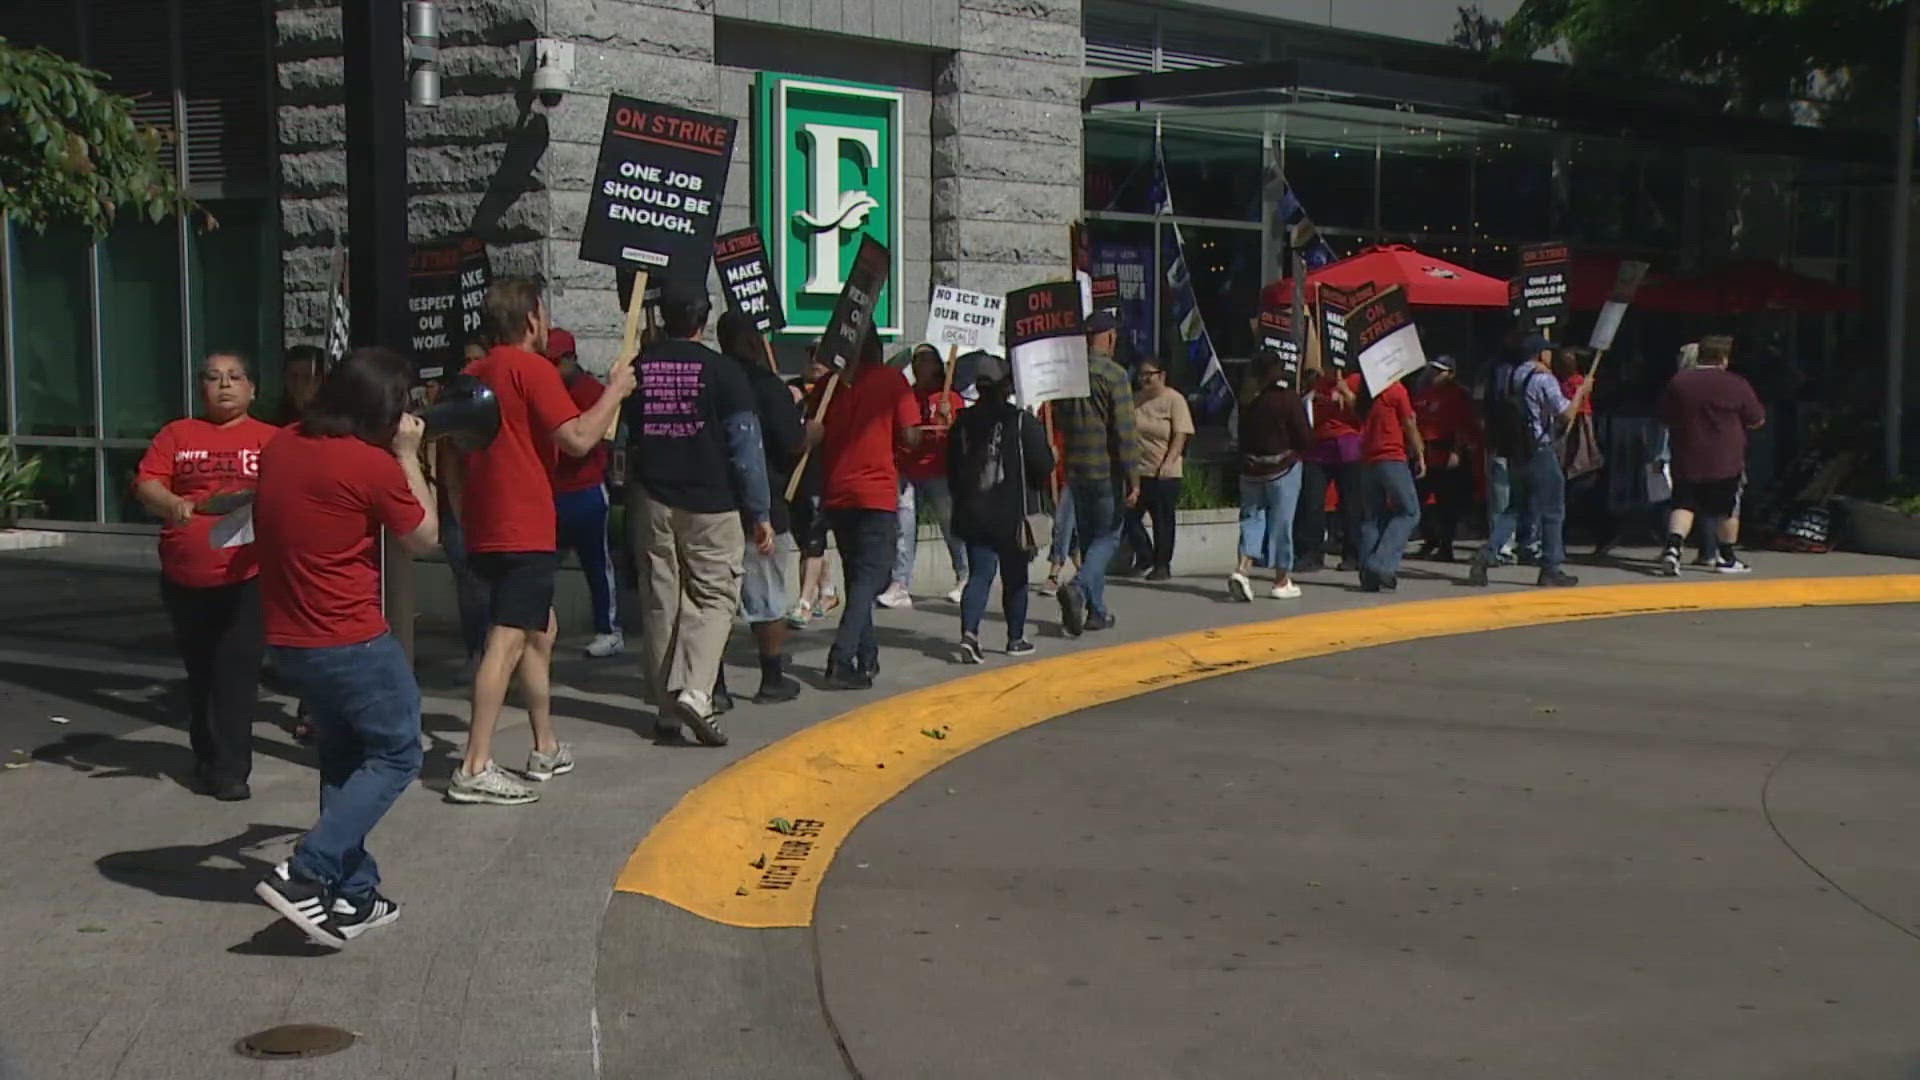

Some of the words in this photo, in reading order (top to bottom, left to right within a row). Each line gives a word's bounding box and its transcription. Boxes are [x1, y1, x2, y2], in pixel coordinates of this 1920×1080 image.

[616, 108, 646, 132] ON
[652, 116, 727, 146] STRIKE
[620, 162, 662, 183] ONE
[665, 170, 702, 192] JOB
[603, 180, 680, 208] SHOULD
[684, 196, 711, 216] BE
[803, 123, 879, 293] F
[608, 204, 696, 235] ENOUGH.
[727, 261, 762, 283] MAKE
[732, 278, 768, 300] THEM
[936, 289, 951, 300] NO
[956, 292, 979, 306] ICE
[984, 296, 1000, 310] IN
[740, 297, 770, 315] PAY.
[1028, 291, 1052, 310] ON
[419, 315, 444, 330] OUR
[934, 307, 959, 320] OUR
[963, 313, 995, 328] CUP!
[1366, 304, 1386, 320] ON
[1016, 311, 1076, 336] STRIKE
[1360, 312, 1405, 345] STRIKE
[412, 333, 450, 350] WORK.
